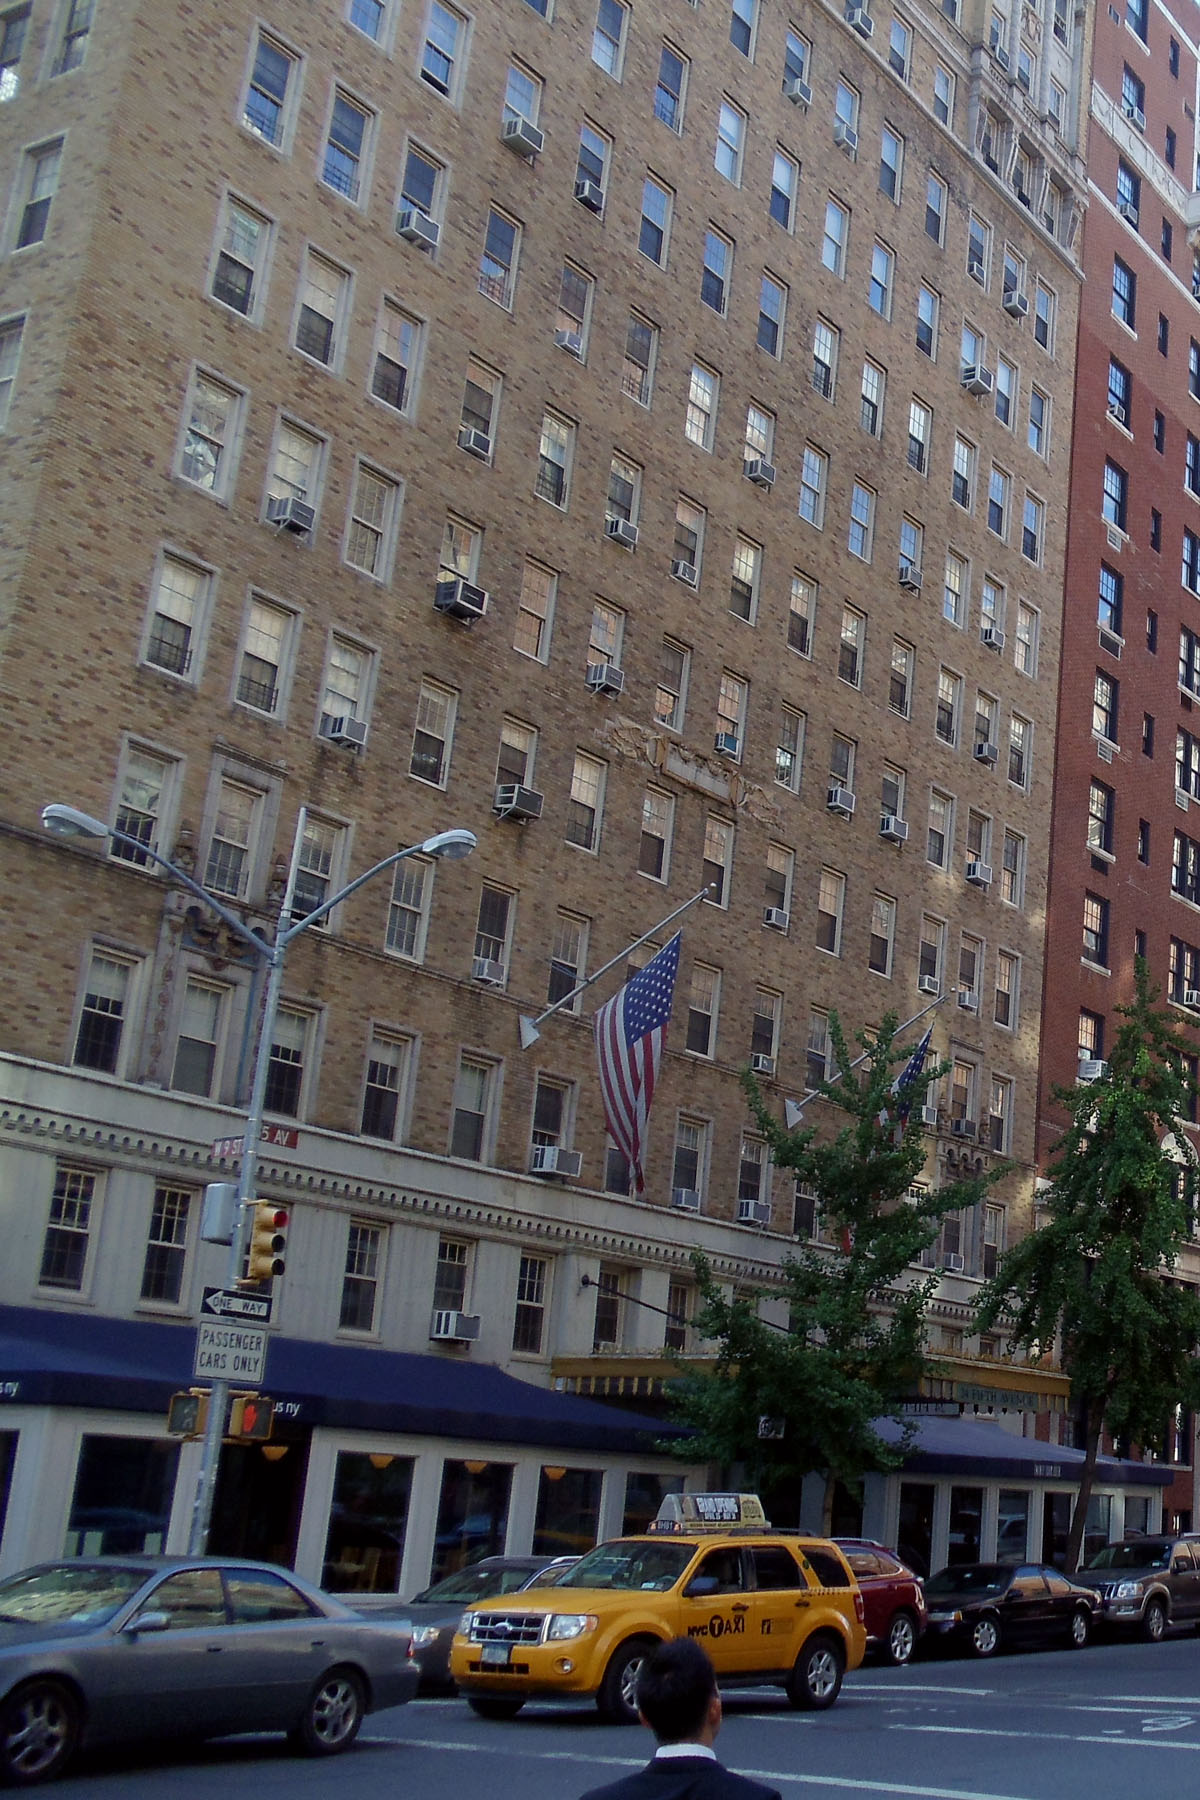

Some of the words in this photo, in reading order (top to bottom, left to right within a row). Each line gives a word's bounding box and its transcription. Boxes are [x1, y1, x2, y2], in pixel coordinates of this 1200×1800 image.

[261, 1125, 270, 1140] 5
[273, 1129, 290, 1146] AV
[224, 1140, 231, 1155] 9
[212, 1296, 233, 1310] ONE
[242, 1301, 264, 1314] WAY
[201, 1329, 262, 1352] PASSENGER
[199, 1351, 227, 1370] CARS
[233, 1355, 260, 1373] ONLY
[285, 1402, 301, 1417] ny
[687, 1625, 708, 1637] NYC
[709, 1614, 745, 1638] TAXI
